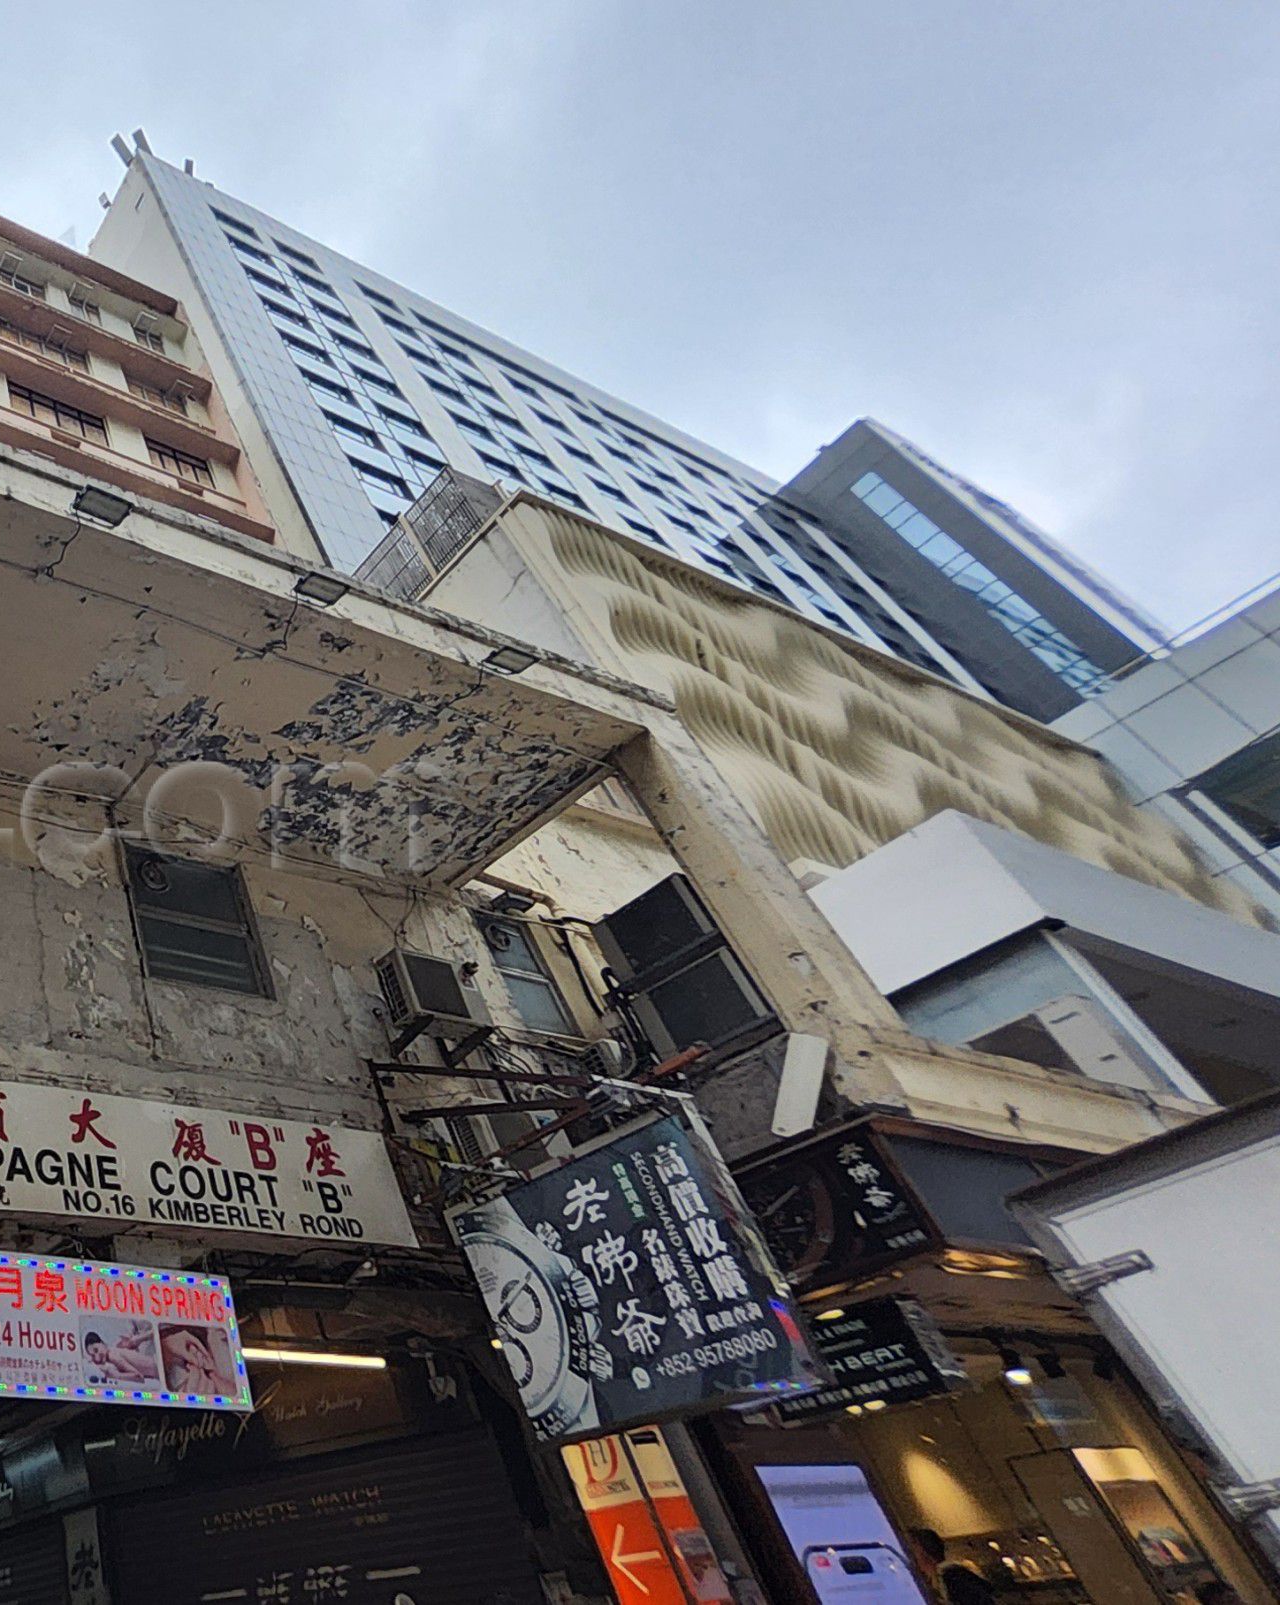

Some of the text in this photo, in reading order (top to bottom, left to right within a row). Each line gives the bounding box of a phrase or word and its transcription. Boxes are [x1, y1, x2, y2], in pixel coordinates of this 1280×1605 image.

[62, 1188, 364, 1239] NO.16 KIMBERLEY ROND
[150, 1161, 279, 1208] COURT
[303, 1180, 353, 1214] "B"
[630, 1151, 710, 1302] SECONDHAND WATCH
[650, 1142, 749, 1301] 高價收購
[563, 1177, 667, 1355] 老佛爺
[75, 1278, 225, 1322] MOON SPRING
[19, 1321, 76, 1351] Hours
[656, 1351, 698, 1377] +852
[694, 1327, 778, 1368] 95788080
[124, 1411, 226, 1465] Lafayette
[201, 1484, 384, 1536] LAFAYETTE WATCH
